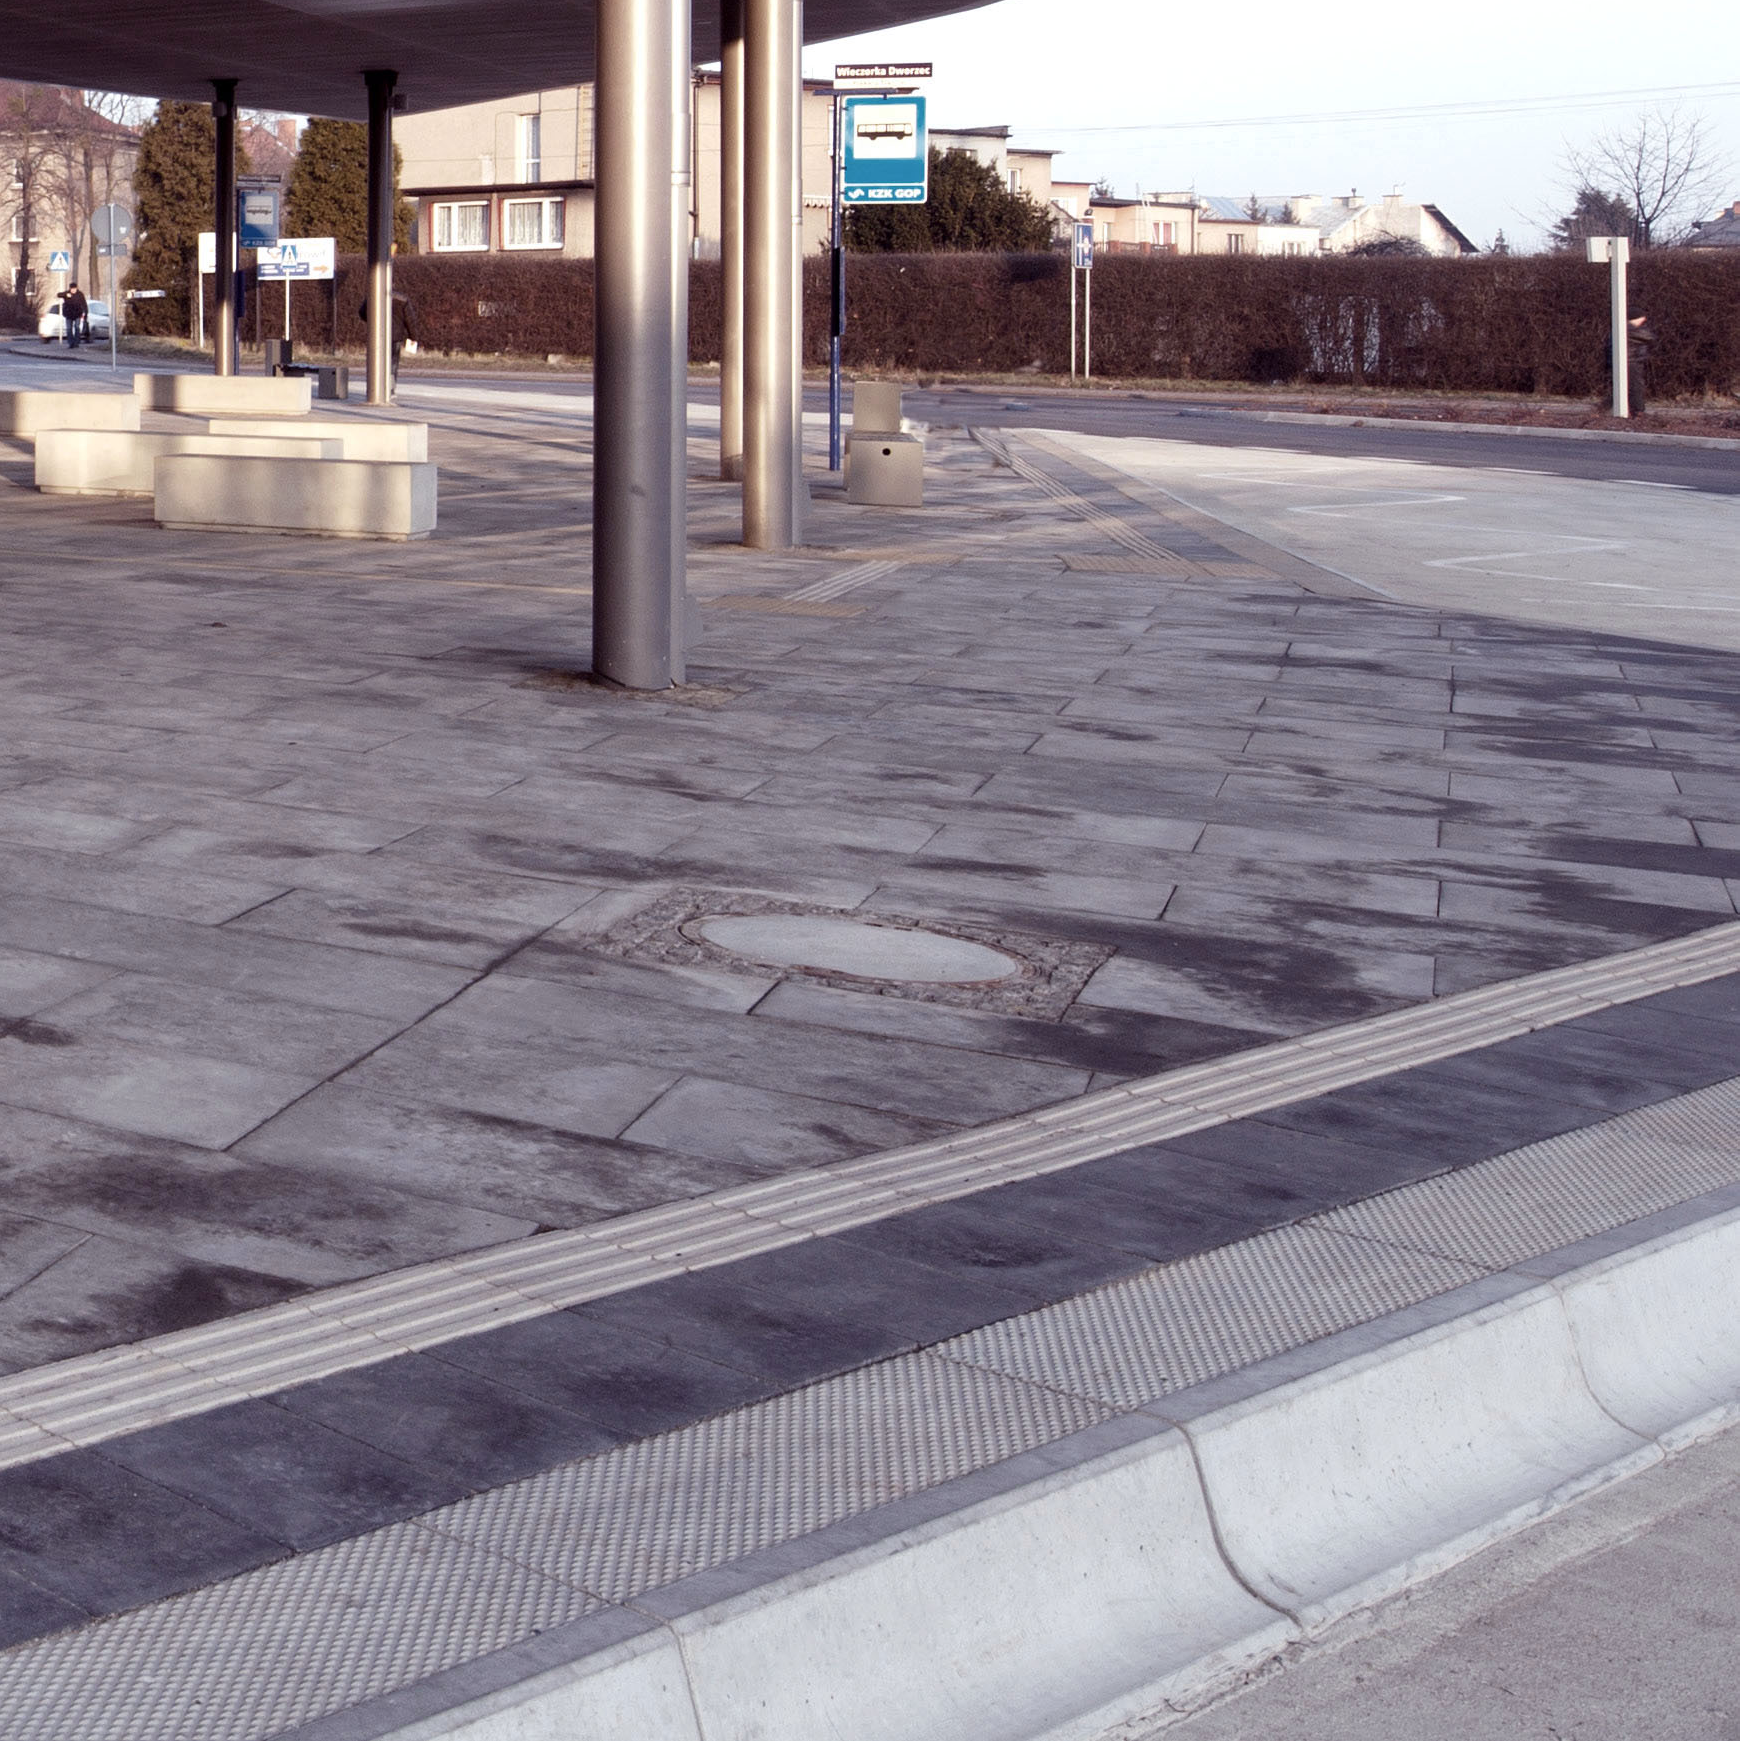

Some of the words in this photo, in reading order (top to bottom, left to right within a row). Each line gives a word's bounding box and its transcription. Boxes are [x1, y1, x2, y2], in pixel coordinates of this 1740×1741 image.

[836, 66, 887, 77] Wieczorka
[888, 64, 931, 76] Dworzec
[868, 188, 893, 199] KZK
[894, 188, 922, 199] GOP
